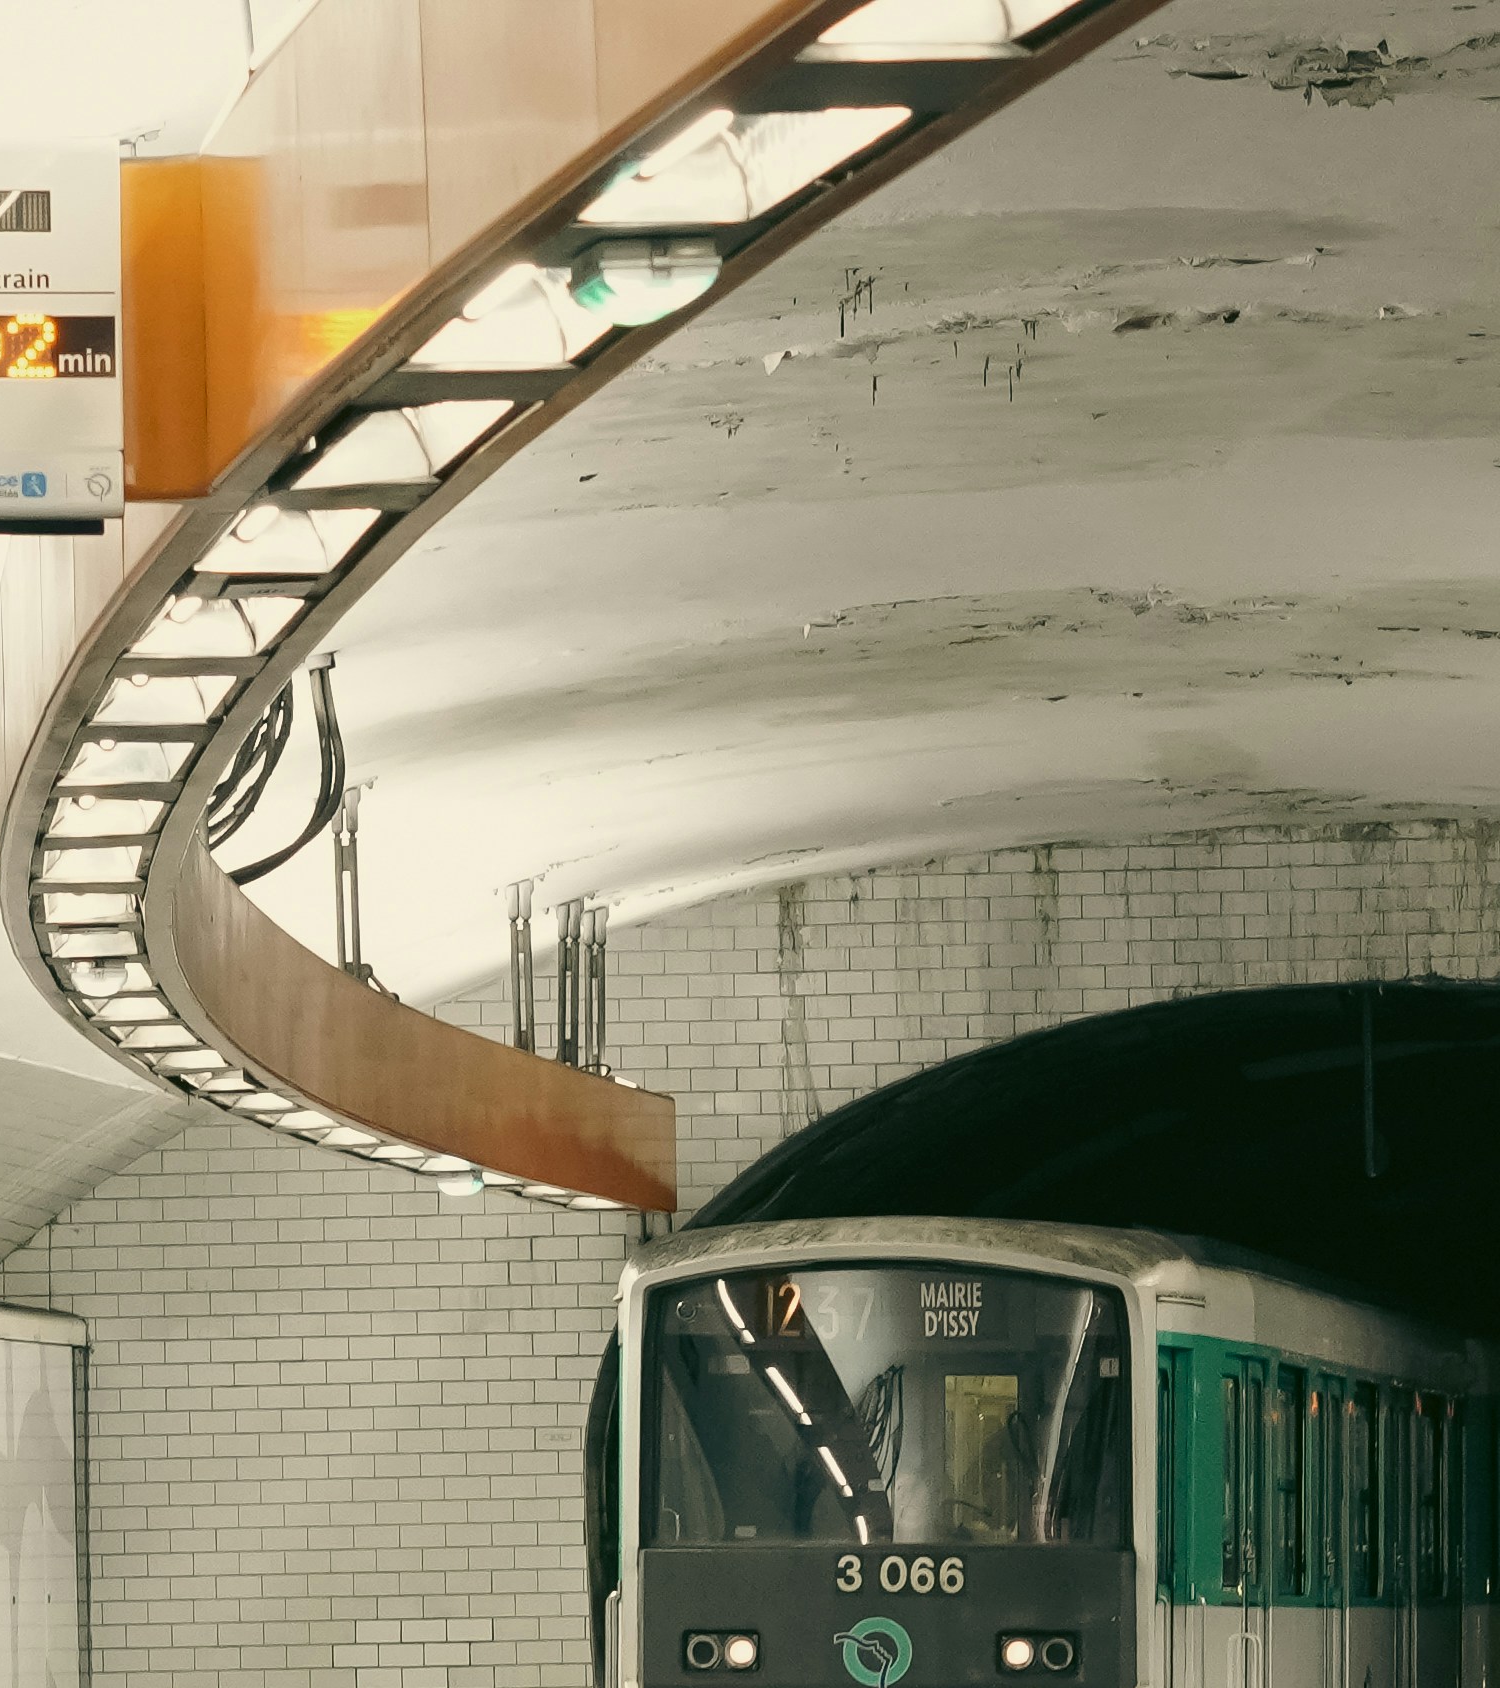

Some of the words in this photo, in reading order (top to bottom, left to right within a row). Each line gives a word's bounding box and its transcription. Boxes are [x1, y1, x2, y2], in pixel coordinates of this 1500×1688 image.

[58, 350, 112, 374] min
[920, 1282, 982, 1307] MAIRIE
[767, 1282, 801, 1338] 12
[924, 1311, 980, 1338] D'ISSY
[837, 1554, 862, 1592] 3
[880, 1555, 965, 1594] 066
